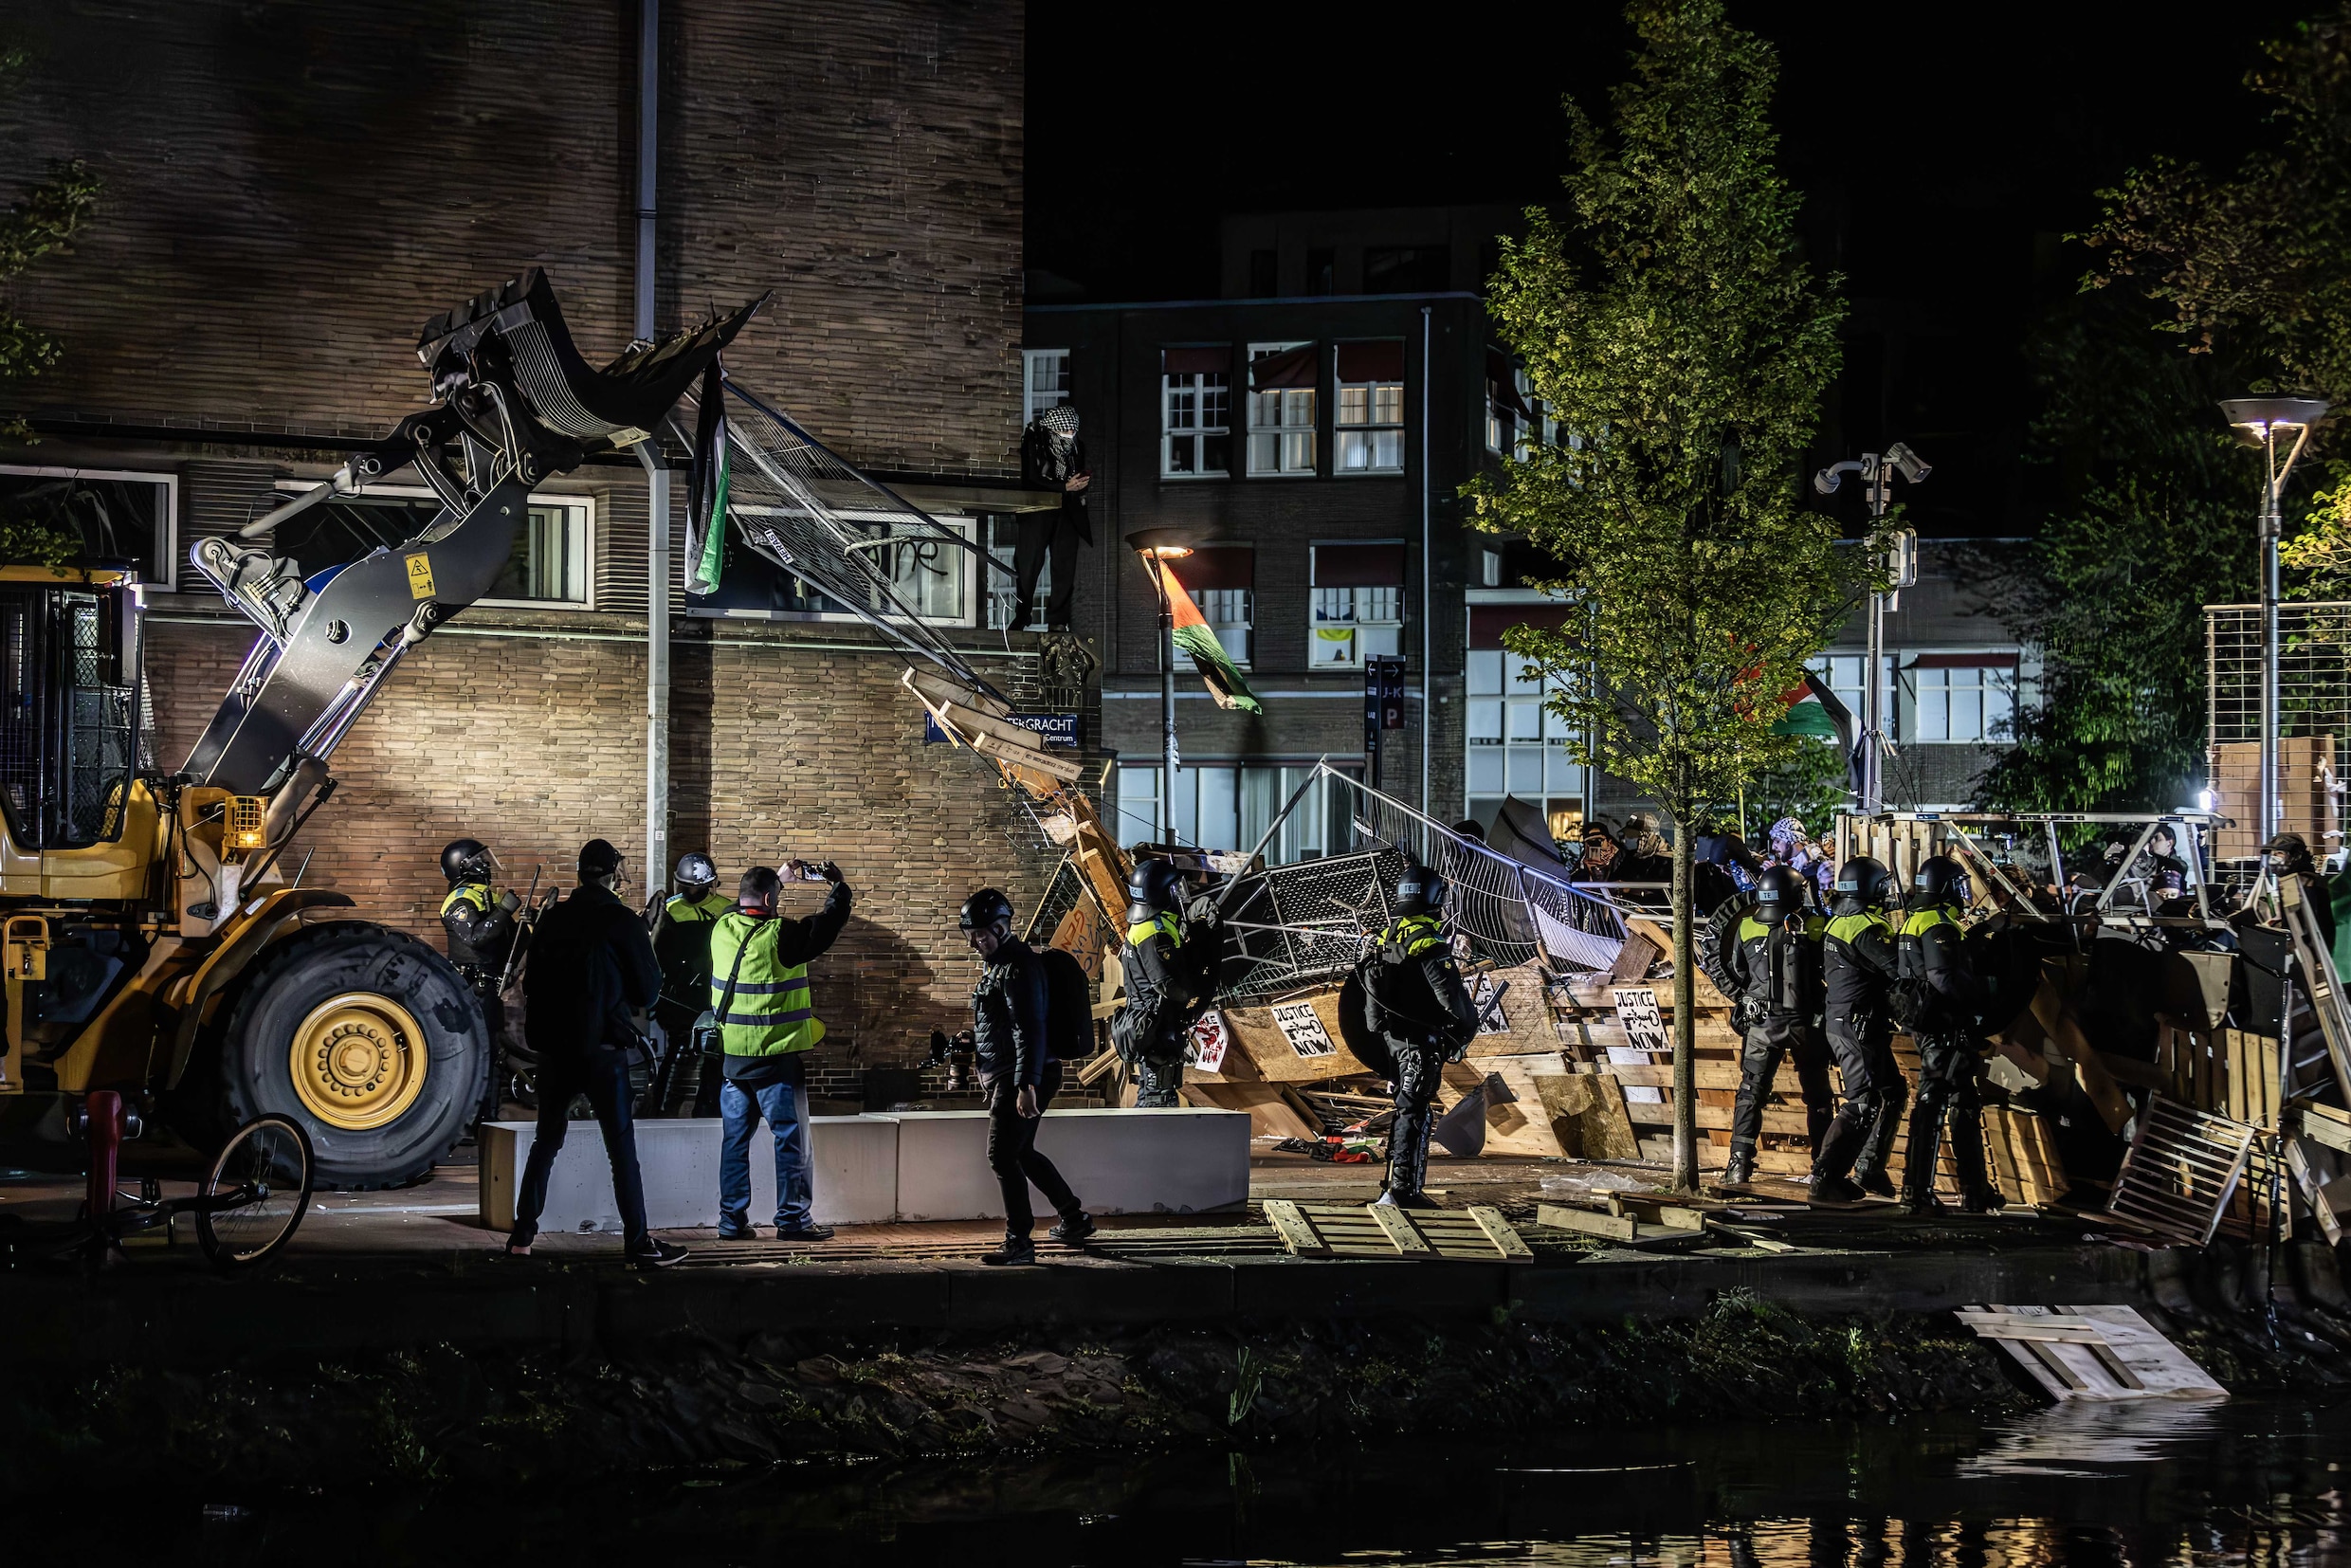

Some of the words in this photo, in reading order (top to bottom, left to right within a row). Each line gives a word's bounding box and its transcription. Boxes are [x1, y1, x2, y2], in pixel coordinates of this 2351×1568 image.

[1382, 686, 1402, 698] J-K
[1387, 708, 1397, 726] P
[1045, 734, 1074, 742] Centrum
[1614, 991, 1655, 1008] JUSTICE
[1273, 1004, 1314, 1022] JUSTICE
[1291, 1038, 1329, 1056] NOW
[1627, 1031, 1664, 1049] NOW
